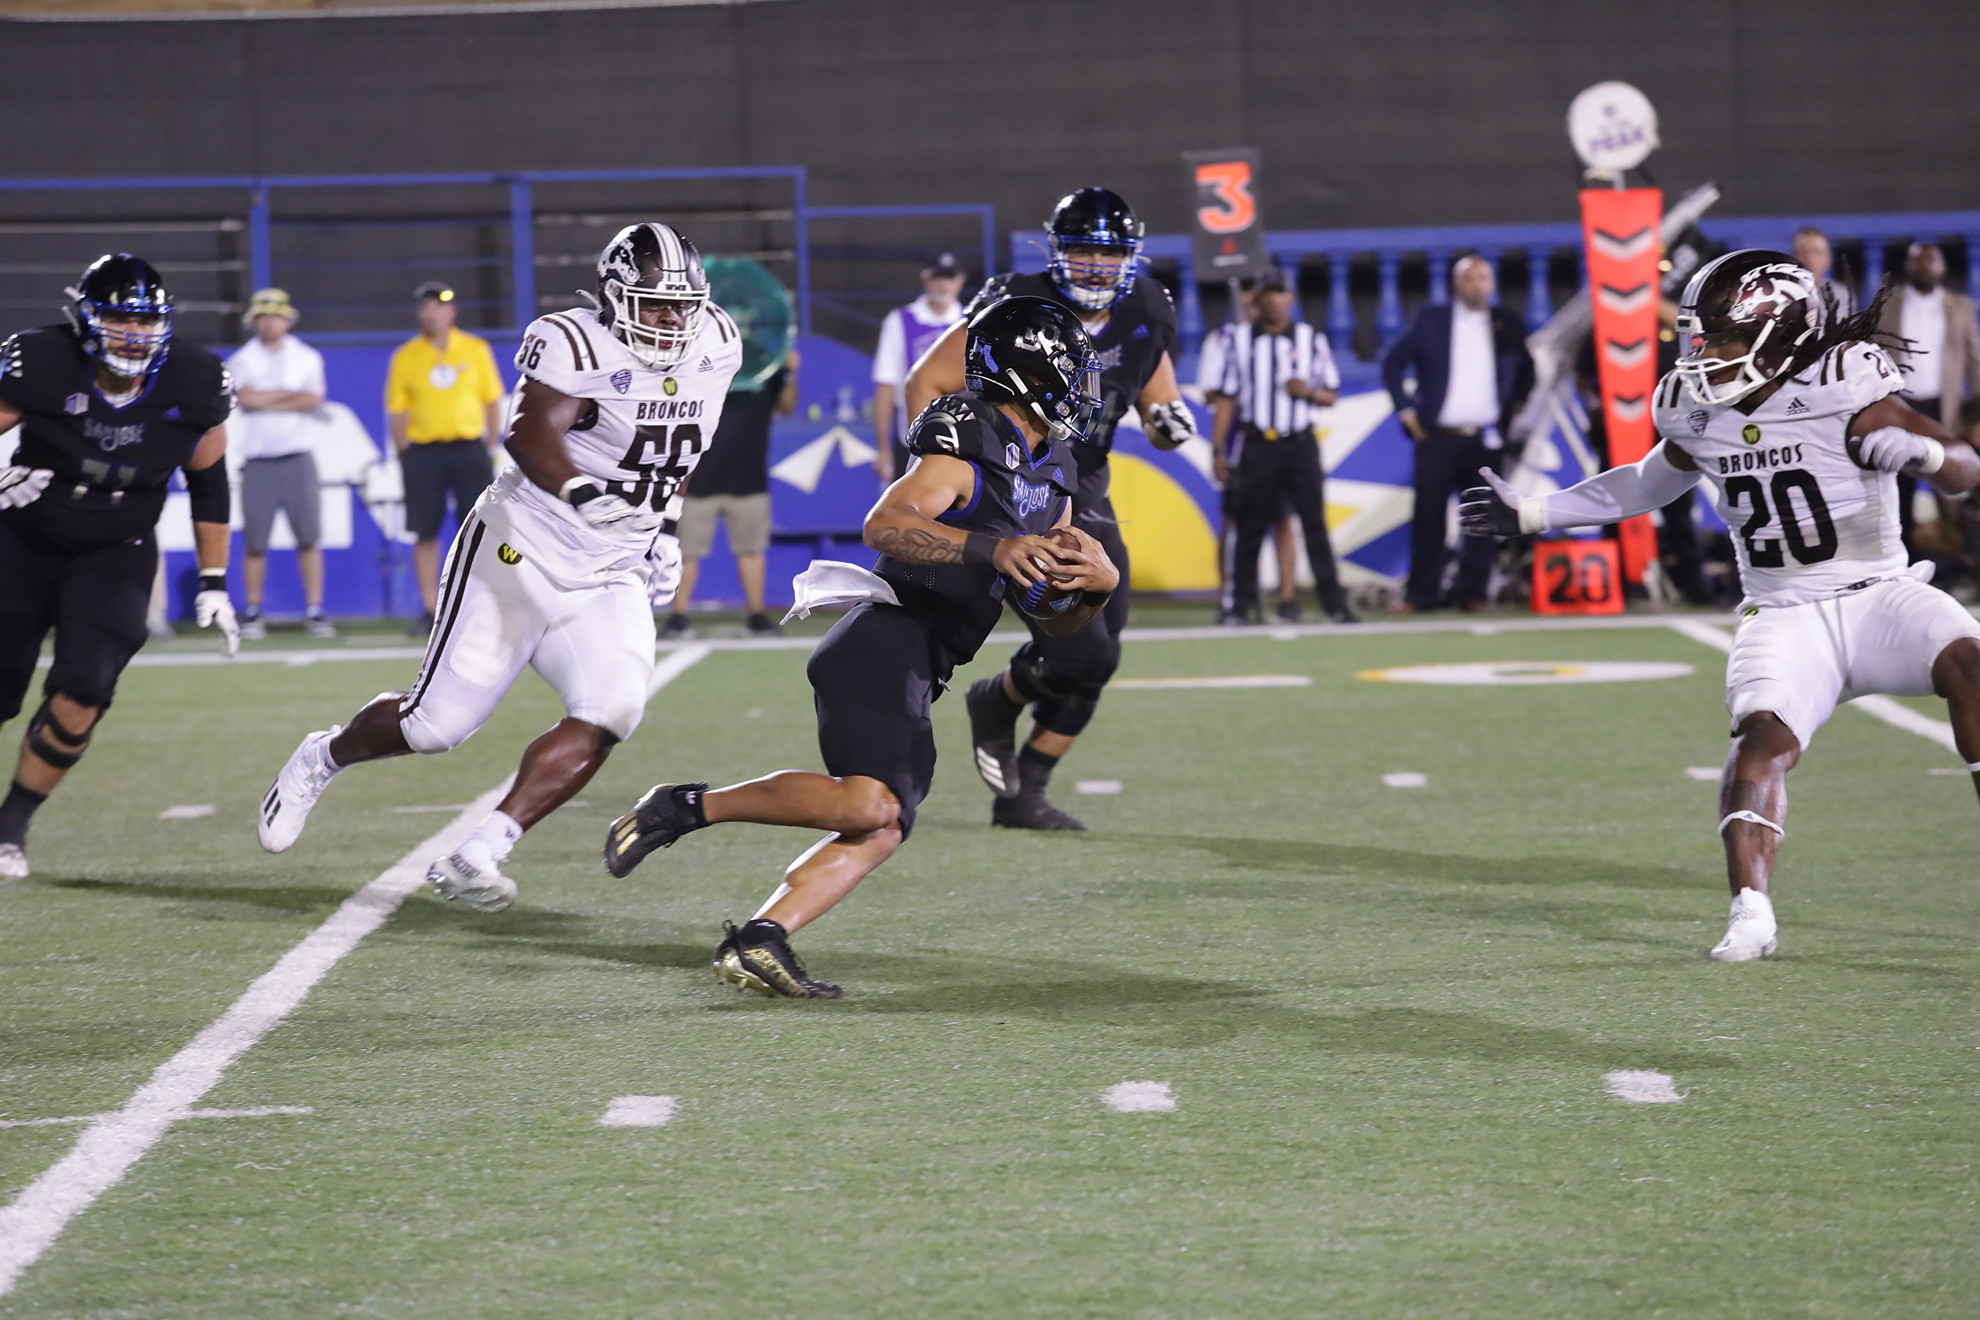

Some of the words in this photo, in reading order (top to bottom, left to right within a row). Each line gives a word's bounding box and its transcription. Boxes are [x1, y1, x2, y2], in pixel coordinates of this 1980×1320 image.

[1195, 161, 1256, 234] 3
[518, 333, 547, 371] 56
[635, 400, 704, 419] BRONCOS
[605, 424, 702, 513] 56
[1718, 443, 1803, 474] BRONCOS
[1725, 468, 1839, 568] 20
[1545, 553, 1610, 605] 20
